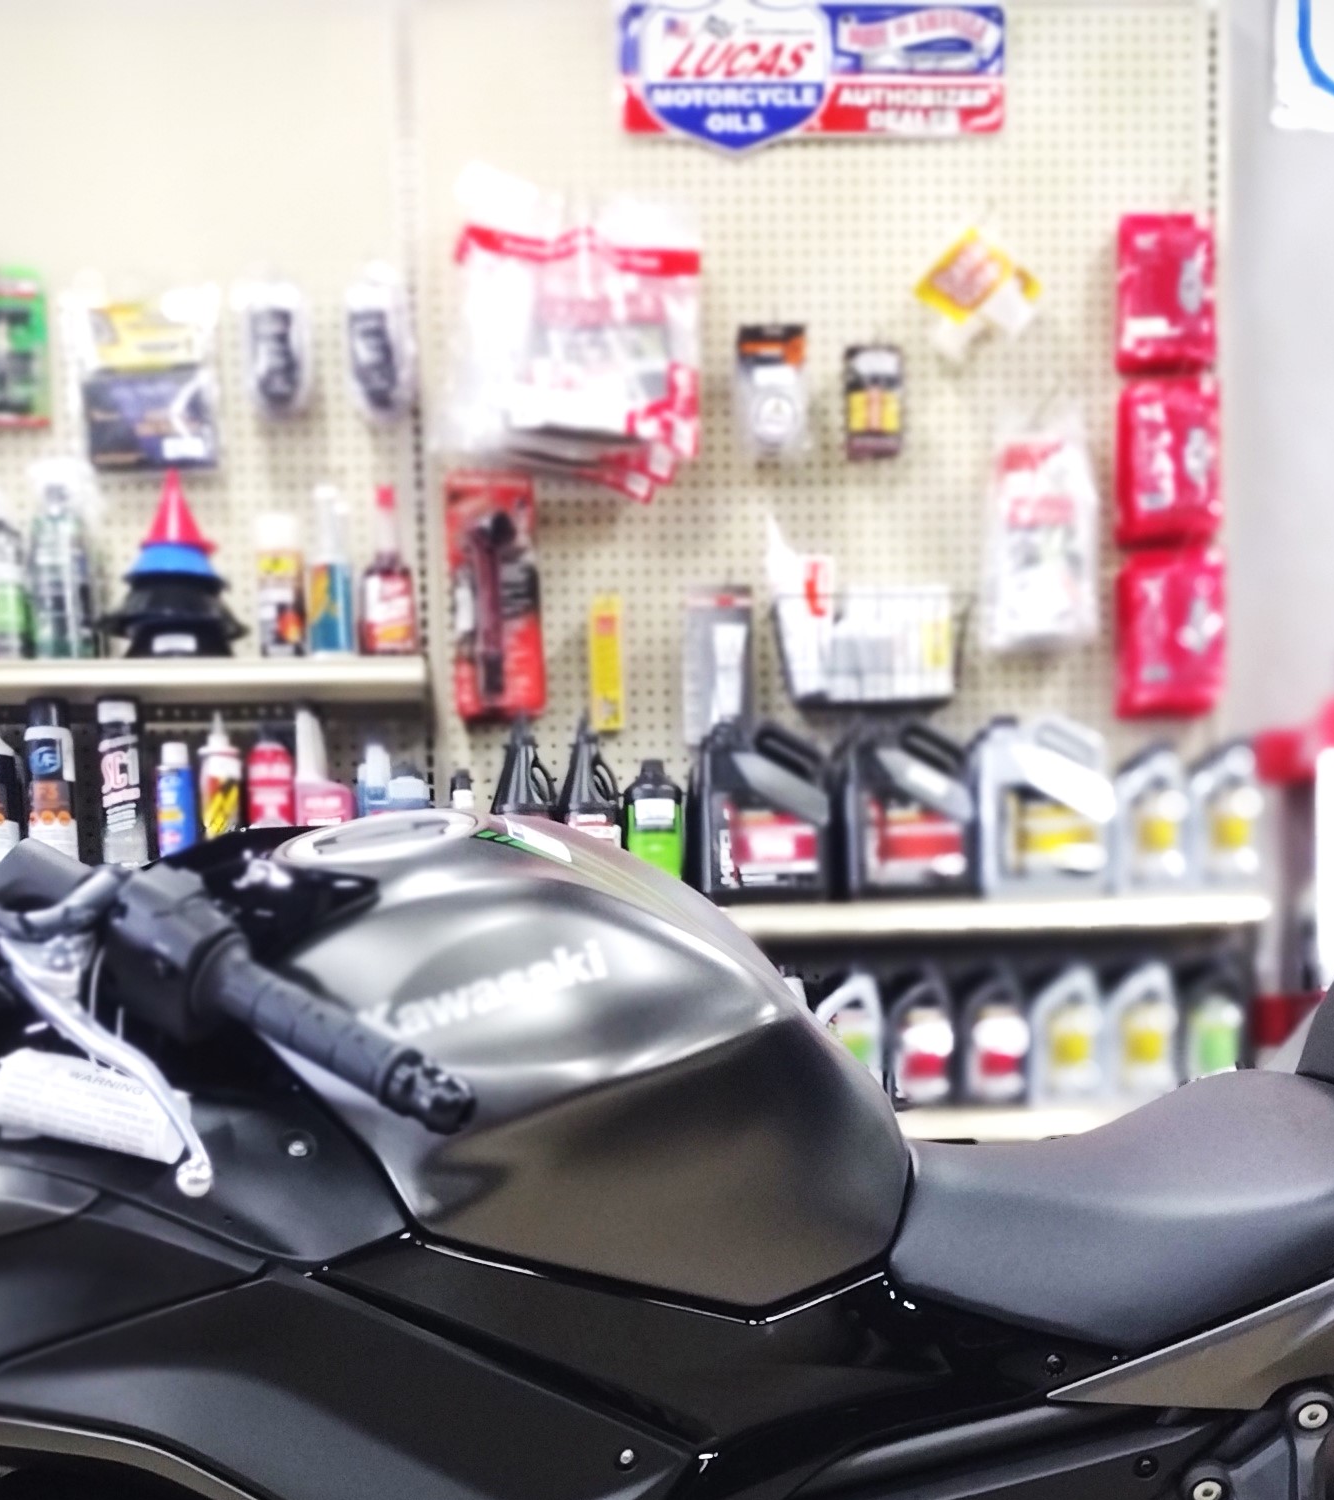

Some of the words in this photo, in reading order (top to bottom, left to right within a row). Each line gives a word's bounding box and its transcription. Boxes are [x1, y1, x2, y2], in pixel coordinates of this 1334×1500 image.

[666, 42, 814, 79] LUCAS
[651, 86, 817, 108] MOTORCYCLE
[704, 111, 767, 134] OILS
[69, 1070, 145, 1096] WARNING
